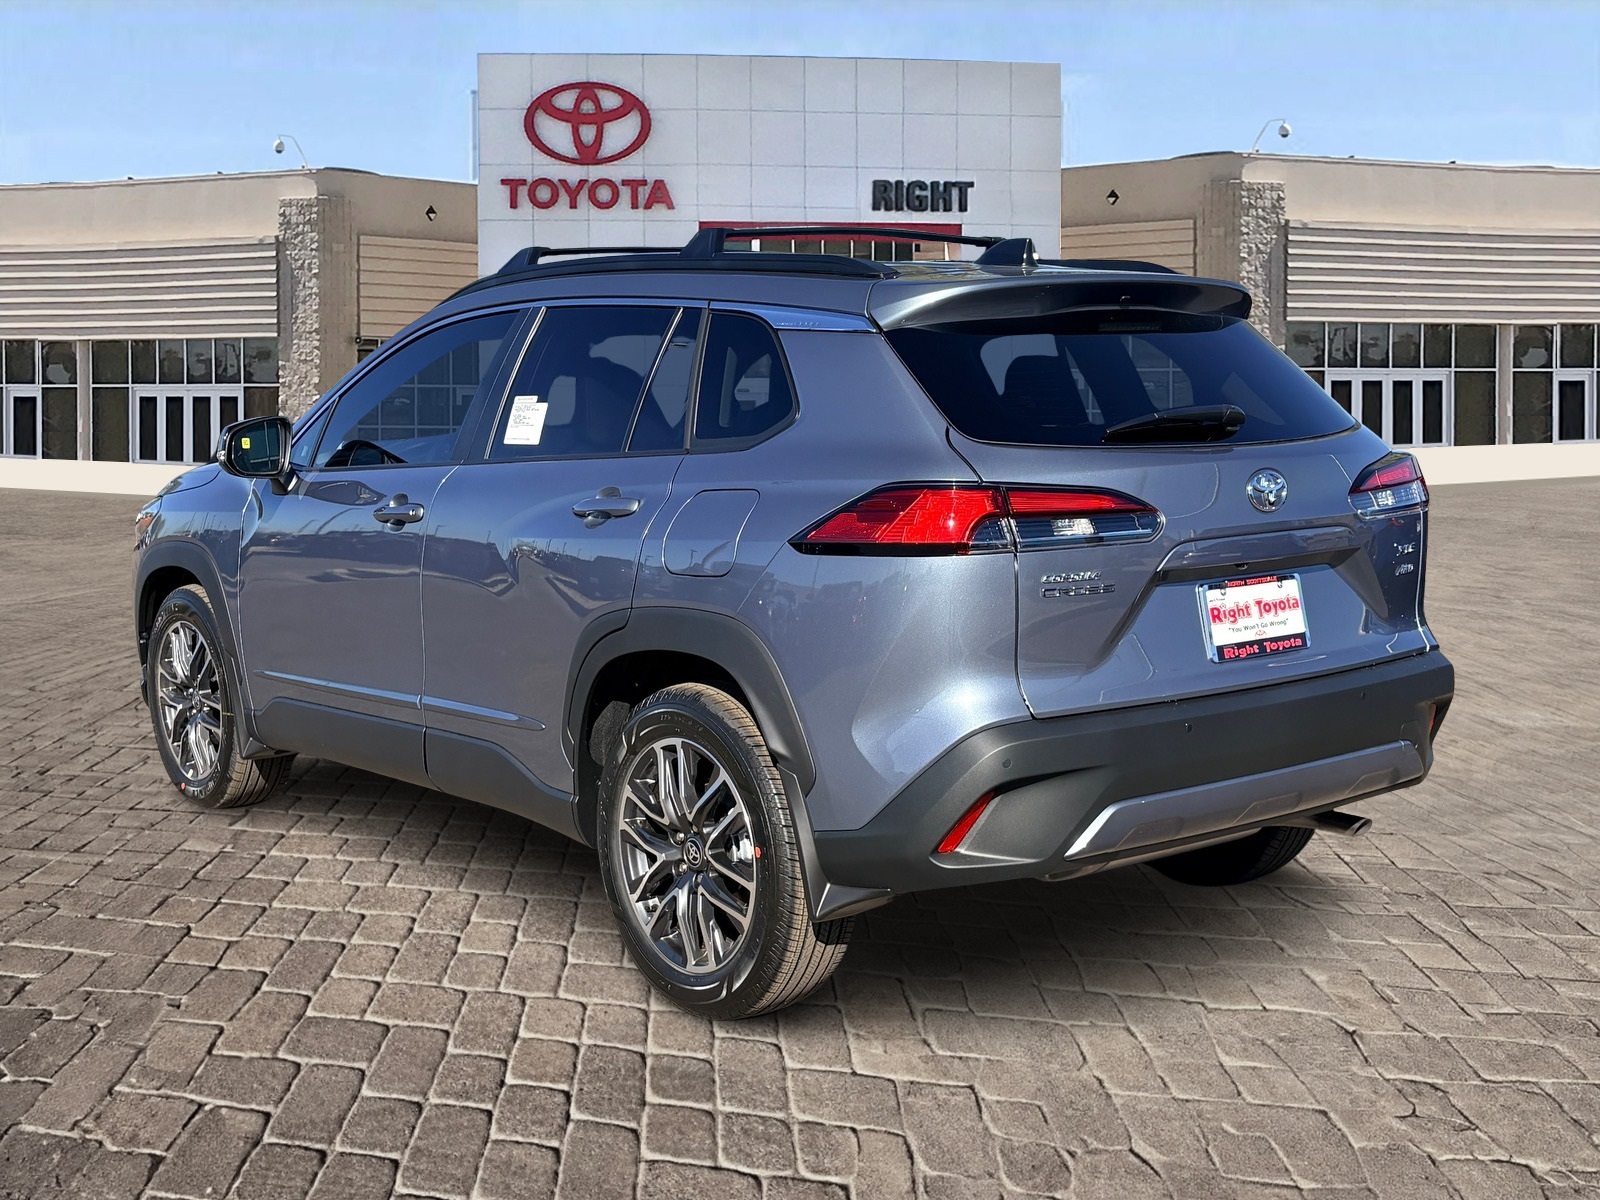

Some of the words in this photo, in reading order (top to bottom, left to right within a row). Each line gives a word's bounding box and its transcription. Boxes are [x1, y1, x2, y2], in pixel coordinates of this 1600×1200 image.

[500, 177, 675, 210] TOYOTA
[872, 179, 974, 212] RIGHT
[1040, 583, 1116, 598] CROSS
[1209, 600, 1252, 624] Right
[1254, 596, 1300, 619] Toyota
[1243, 623, 1259, 631] Won't
[1223, 644, 1260, 659] Right
[1263, 637, 1303, 653] Toyota
